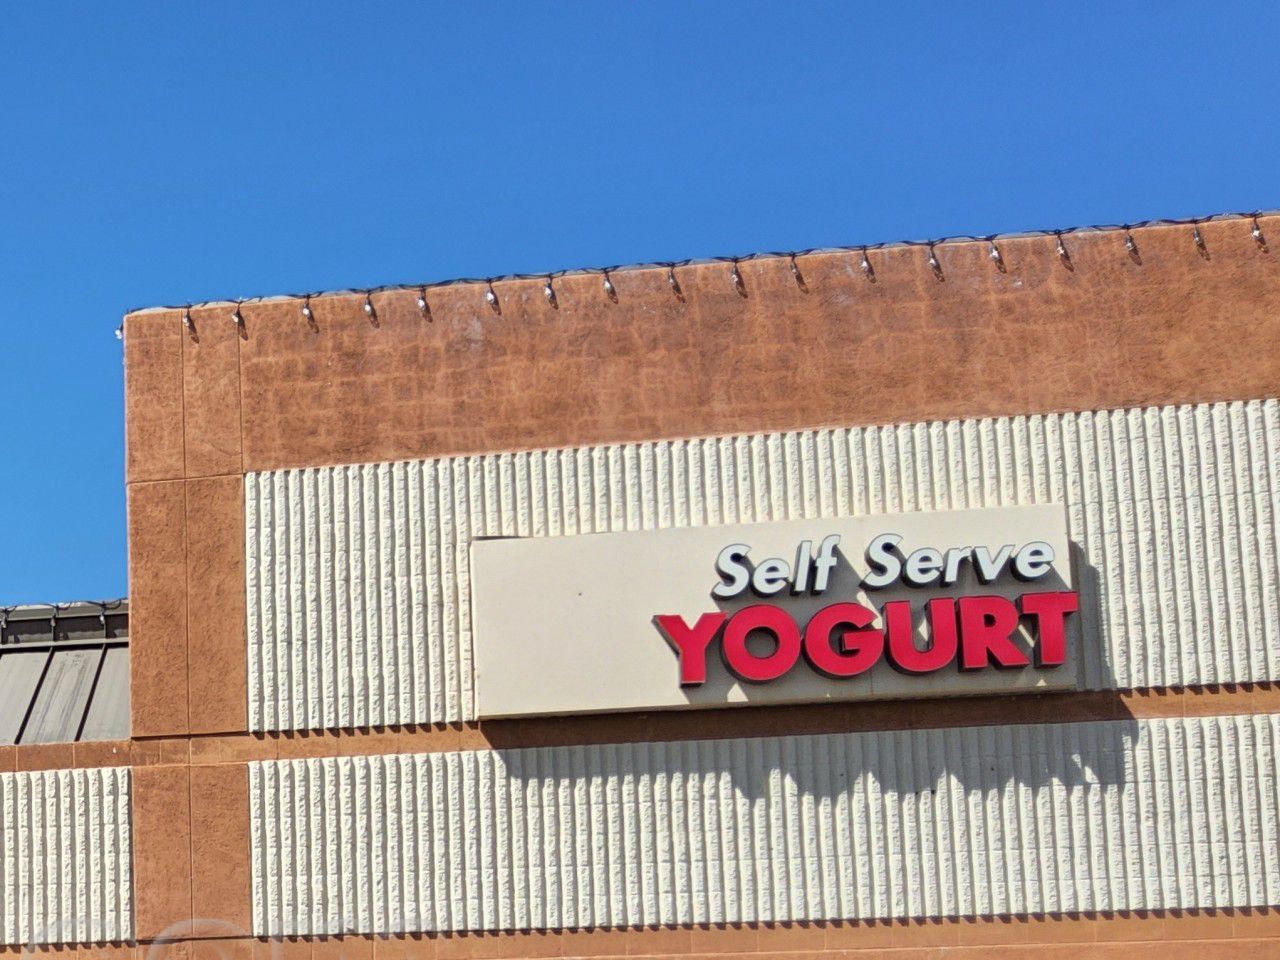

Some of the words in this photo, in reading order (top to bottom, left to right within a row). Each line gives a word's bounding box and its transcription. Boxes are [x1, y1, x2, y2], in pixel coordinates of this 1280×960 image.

[712, 534, 841, 598] Self
[861, 533, 1056, 590] Serve
[653, 592, 1079, 687] YOGURT
